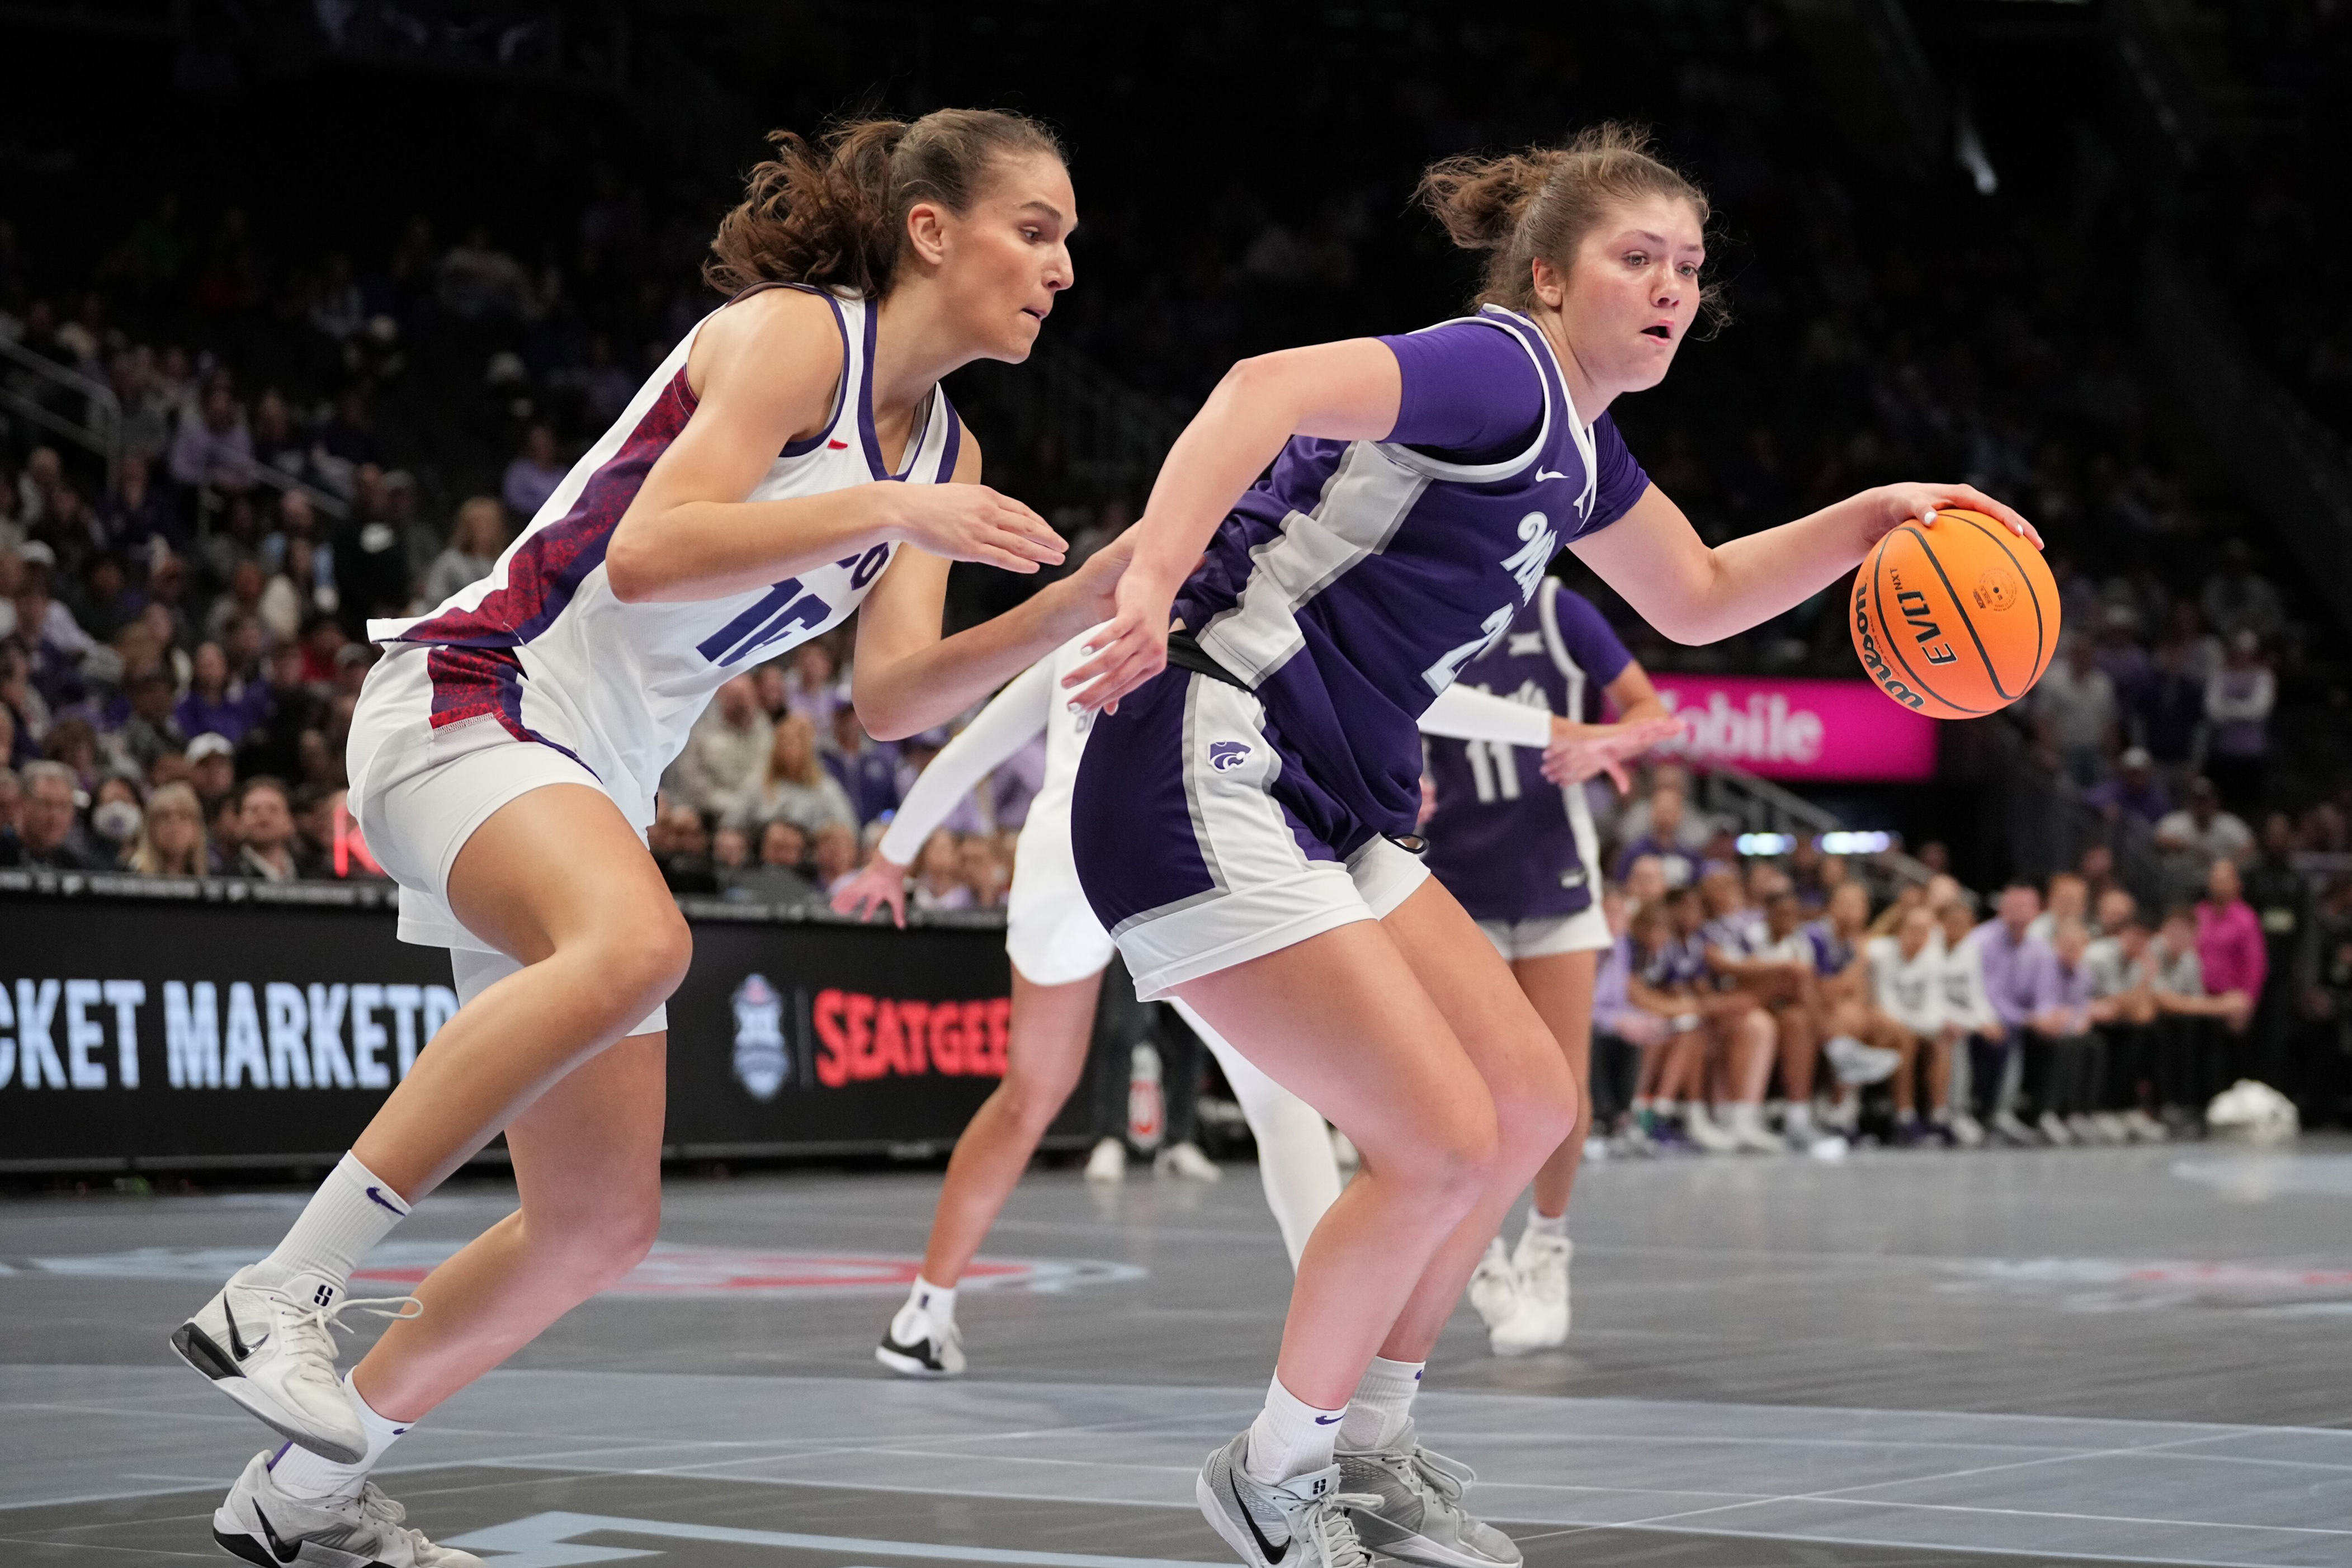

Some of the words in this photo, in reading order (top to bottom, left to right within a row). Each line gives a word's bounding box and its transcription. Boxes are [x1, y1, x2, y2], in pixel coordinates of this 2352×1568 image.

[1890, 568, 1903, 591] NXT
[1855, 582, 1925, 711] Wilson
[1656, 688, 1824, 764] obile
